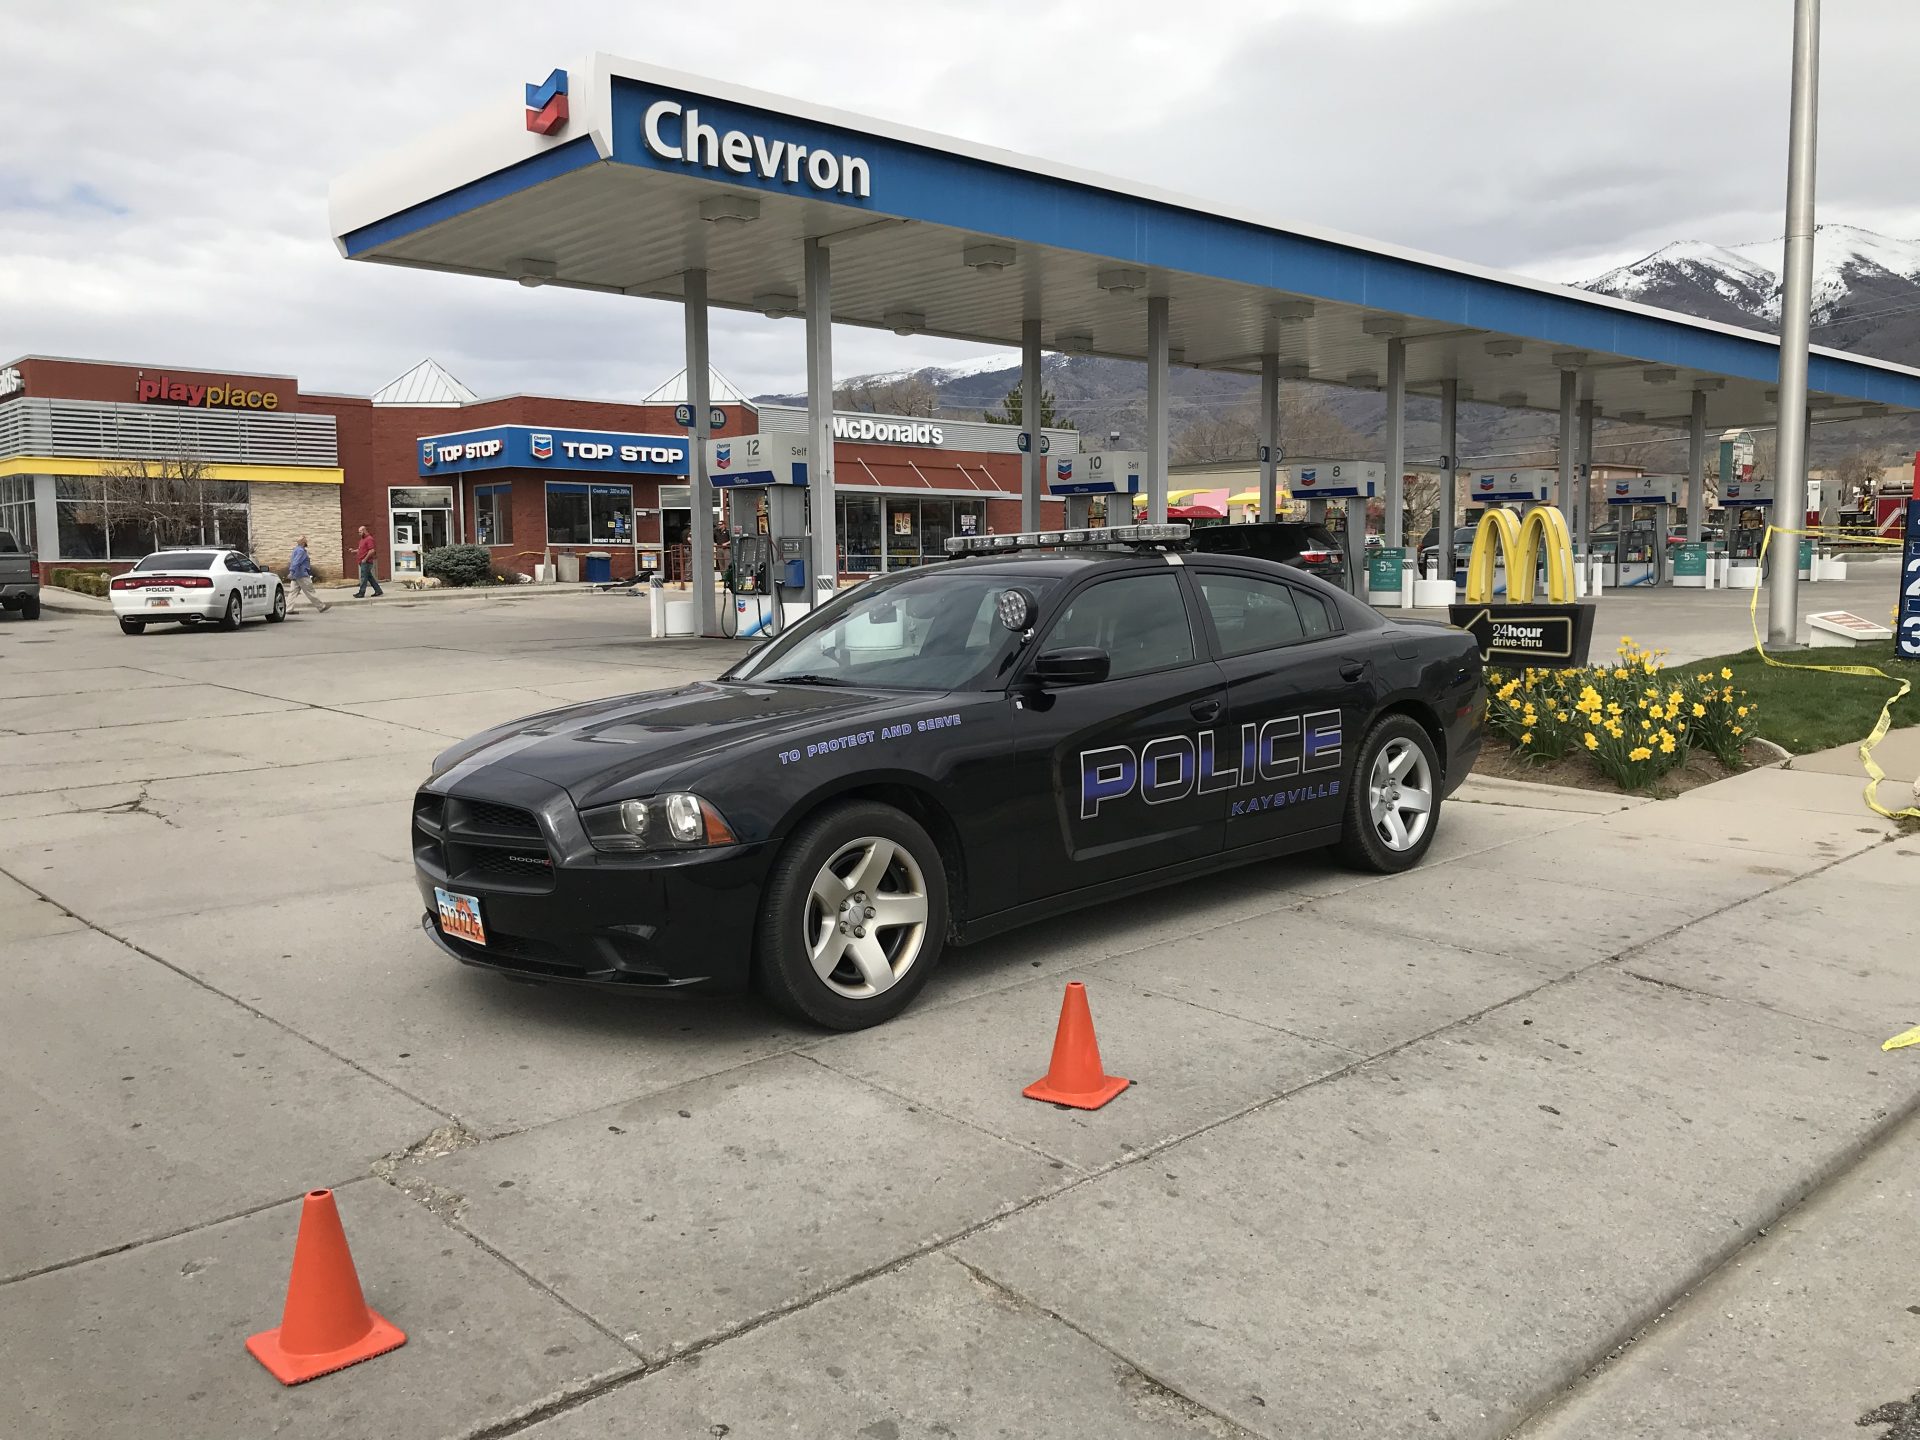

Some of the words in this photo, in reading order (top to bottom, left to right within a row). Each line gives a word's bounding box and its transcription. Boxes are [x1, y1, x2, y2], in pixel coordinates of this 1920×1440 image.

[641, 99, 871, 198] Chevron
[139, 376, 279, 410] playplace
[678, 409, 688, 419] 12
[713, 412, 721, 421] 11
[832, 417, 944, 445] McDonald's
[437, 444, 463, 463] TOP
[465, 439, 501, 459] STOP
[562, 441, 614, 460] TOP
[620, 445, 684, 464] STOP
[746, 439, 760, 456] 12
[791, 446, 807, 457] Self
[1088, 456, 1102, 470] 10
[1127, 461, 1139, 470] Self
[1332, 465, 1341, 477] 8
[1510, 473, 1518, 483] 6
[1643, 479, 1651, 488] 4
[1754, 483, 1761, 492] 2
[242, 583, 267, 600] POLICE
[1492, 636, 1543, 647] drive-thru
[779, 749, 801, 765] TO
[806, 730, 875, 758] PROTECT
[881, 723, 912, 740] AND
[917, 713, 962, 733] SERVE
[1080, 708, 1342, 820] POLICE
[1230, 780, 1341, 817] KAYSVILLE
